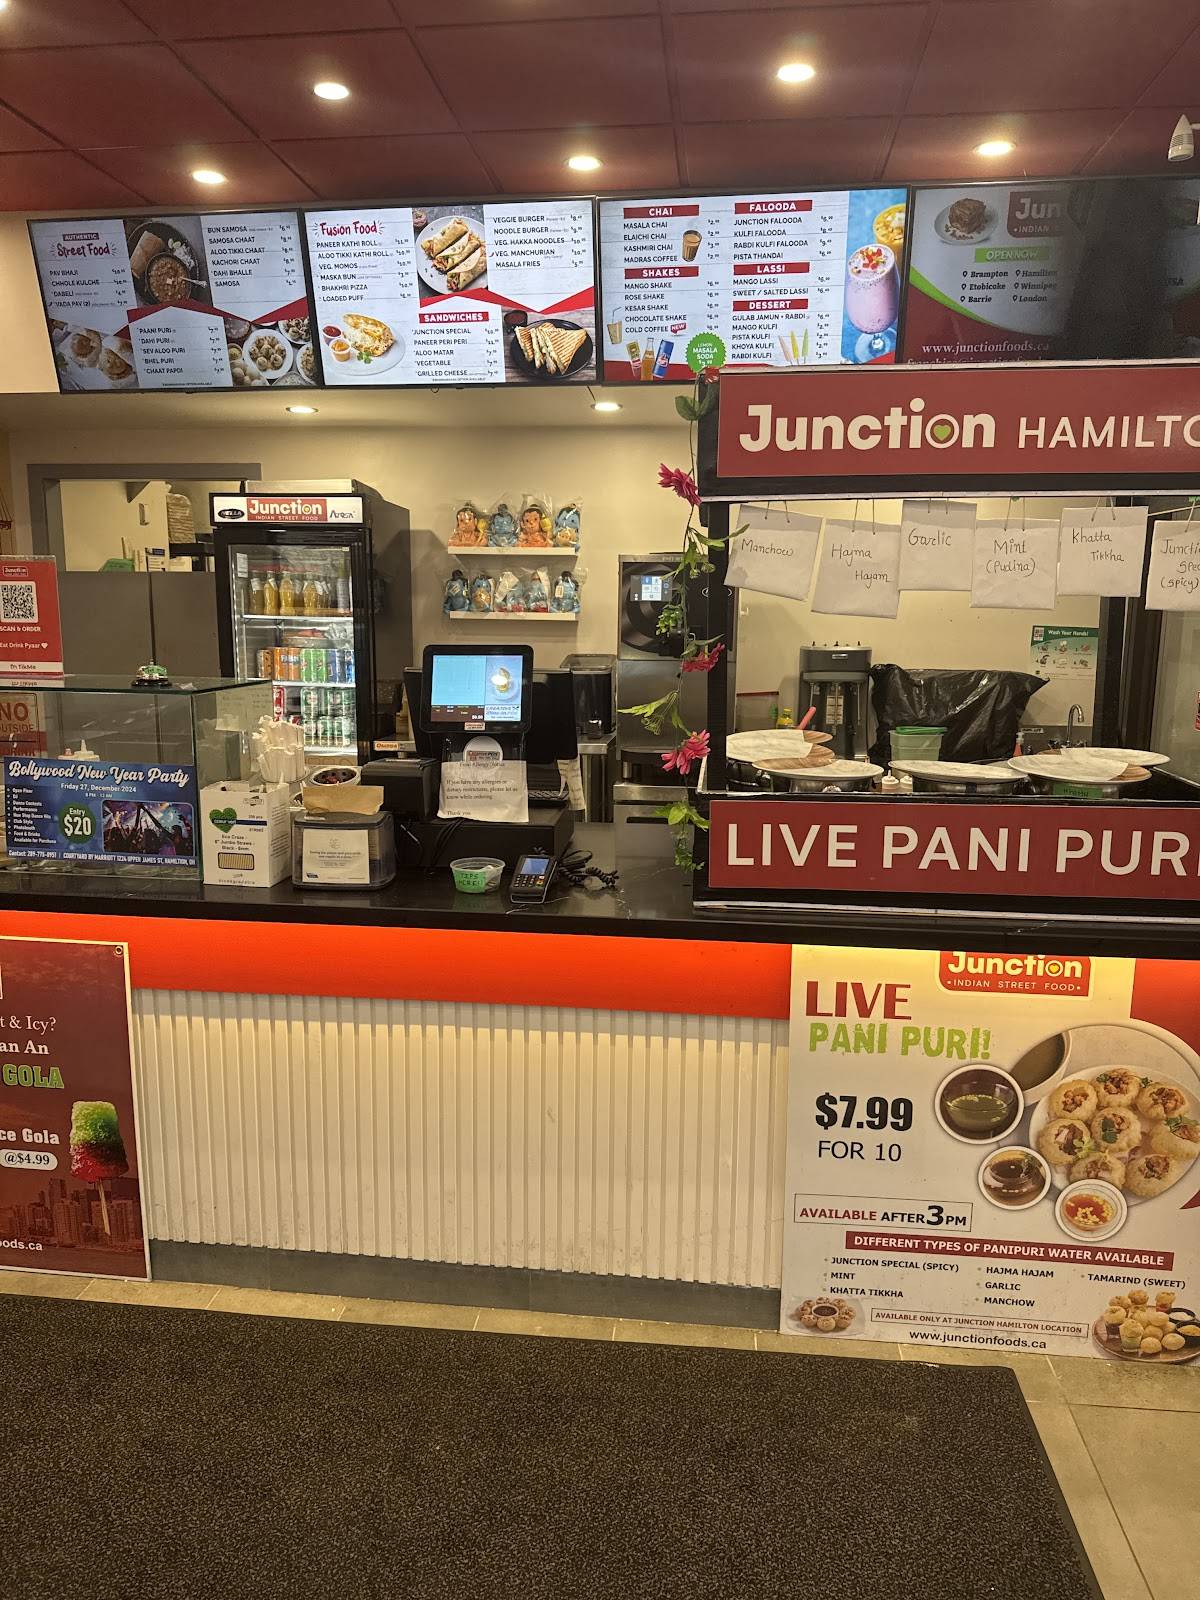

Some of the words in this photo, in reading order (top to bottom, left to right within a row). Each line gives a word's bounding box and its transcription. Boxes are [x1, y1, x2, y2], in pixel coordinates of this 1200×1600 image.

[649, 208, 672, 216] CHAI
[750, 203, 796, 212] FALOODA
[320, 222, 351, 236] Fusion
[353, 220, 377, 234] Food
[57, 243, 86, 258] Street
[87, 243, 110, 255] Food
[642, 269, 680, 277] SHAKES
[971, 270, 1008, 279] Brampton
[749, 301, 791, 310] DESSERT
[424, 313, 483, 322] SANDWICHES
[739, 398, 996, 452] Junction
[249, 500, 322, 515] Junction
[908, 528, 952, 546] Garlic
[1072, 528, 1112, 544] Khatta
[994, 539, 1026, 554] Mint
[831, 544, 872, 567] Hajma
[1091, 550, 1124, 562] Tikkha
[986, 558, 1036, 577] (Pudina)
[855, 570, 891, 589] Hajam
[8, 760, 74, 781] Bollywood
[77, 764, 107, 780] New
[109, 767, 145, 784] Year
[147, 767, 190, 788] Party
[60, 783, 80, 791] Friday
[69, 808, 85, 816] Entry
[63, 814, 92, 836] $20
[728, 823, 858, 868] LIVE
[882, 825, 1030, 873] PANI
[1055, 828, 1200, 877] PUR
[948, 951, 1082, 978] Junction
[953, 979, 990, 987] INDIAN
[998, 981, 1037, 989] STREET
[1044, 983, 1075, 991] FOOD
[806, 980, 912, 1020] LIVE
[10, 1016, 21, 1028] &
[26, 1016, 56, 1035] Icy?
[24, 1040, 49, 1054] An
[809, 1022, 888, 1054] PANI
[900, 1026, 991, 1060] PURI!
[2, 1064, 64, 1089] GOLA
[815, 1092, 913, 1132] $7.99
[22, 1128, 60, 1144] Gola
[5, 1151, 49, 1165] @$4.99
[818, 1140, 865, 1161] FOR
[875, 1143, 901, 1162] 10
[800, 1207, 877, 1221] AVAILABLE
[880, 1211, 925, 1224] AFTER
[926, 1205, 944, 1226] 3
[946, 1215, 967, 1226] PM
[854, 1236, 921, 1249] DIFFERENT
[923, 1240, 961, 1251] TYPES
[964, 1242, 981, 1252] OF
[983, 1244, 1045, 1257] PANIPURI
[1048, 1248, 1092, 1261] WATER
[1094, 1252, 1164, 1266] AVAILABLE
[831, 1257, 879, 1267] JUNCTION
[880, 1259, 920, 1269] SPECIAL
[922, 1262, 959, 1273] (SPICY)
[986, 1267, 1018, 1276] HAJMA
[1021, 1268, 1054, 1278] HAJAM
[830, 1272, 856, 1280] MINT
[1087, 1273, 1141, 1285] TAMARIND
[1143, 1278, 1186, 1290] (SWEET)
[830, 1287, 866, 1296] KHATTA
[868, 1288, 904, 1298] TIKKHA
[985, 1282, 1021, 1291] GARLIC
[984, 1297, 1035, 1307] MANCHOW
[875, 1313, 918, 1321] AVAILABLE
[954, 1318, 995, 1326] JUNCTION
[996, 1321, 1039, 1330] HAMILTON
[1041, 1324, 1082, 1334] LOCATION
[909, 1330, 1047, 1349] www.junctionfoods.ca
